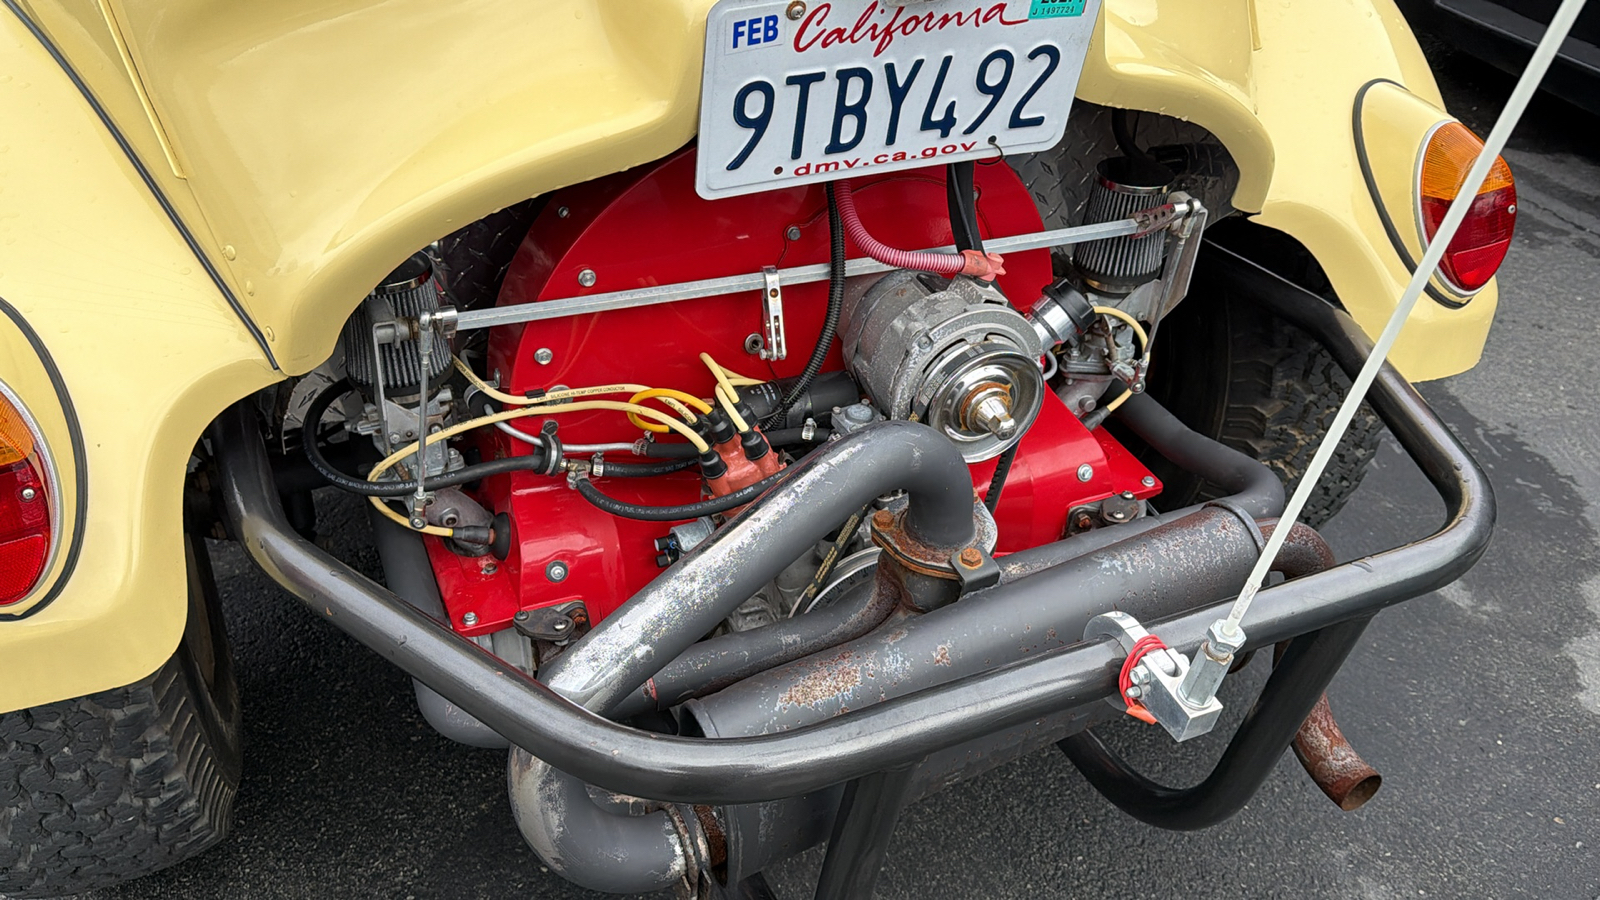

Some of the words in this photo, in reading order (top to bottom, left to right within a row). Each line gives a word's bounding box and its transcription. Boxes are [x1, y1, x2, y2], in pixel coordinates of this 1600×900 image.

[732, 14, 779, 49] FEB
[793, 0, 1030, 58] California
[726, 44, 1061, 171] 9TBY492
[793, 140, 978, 177] dmv.ca.gov
